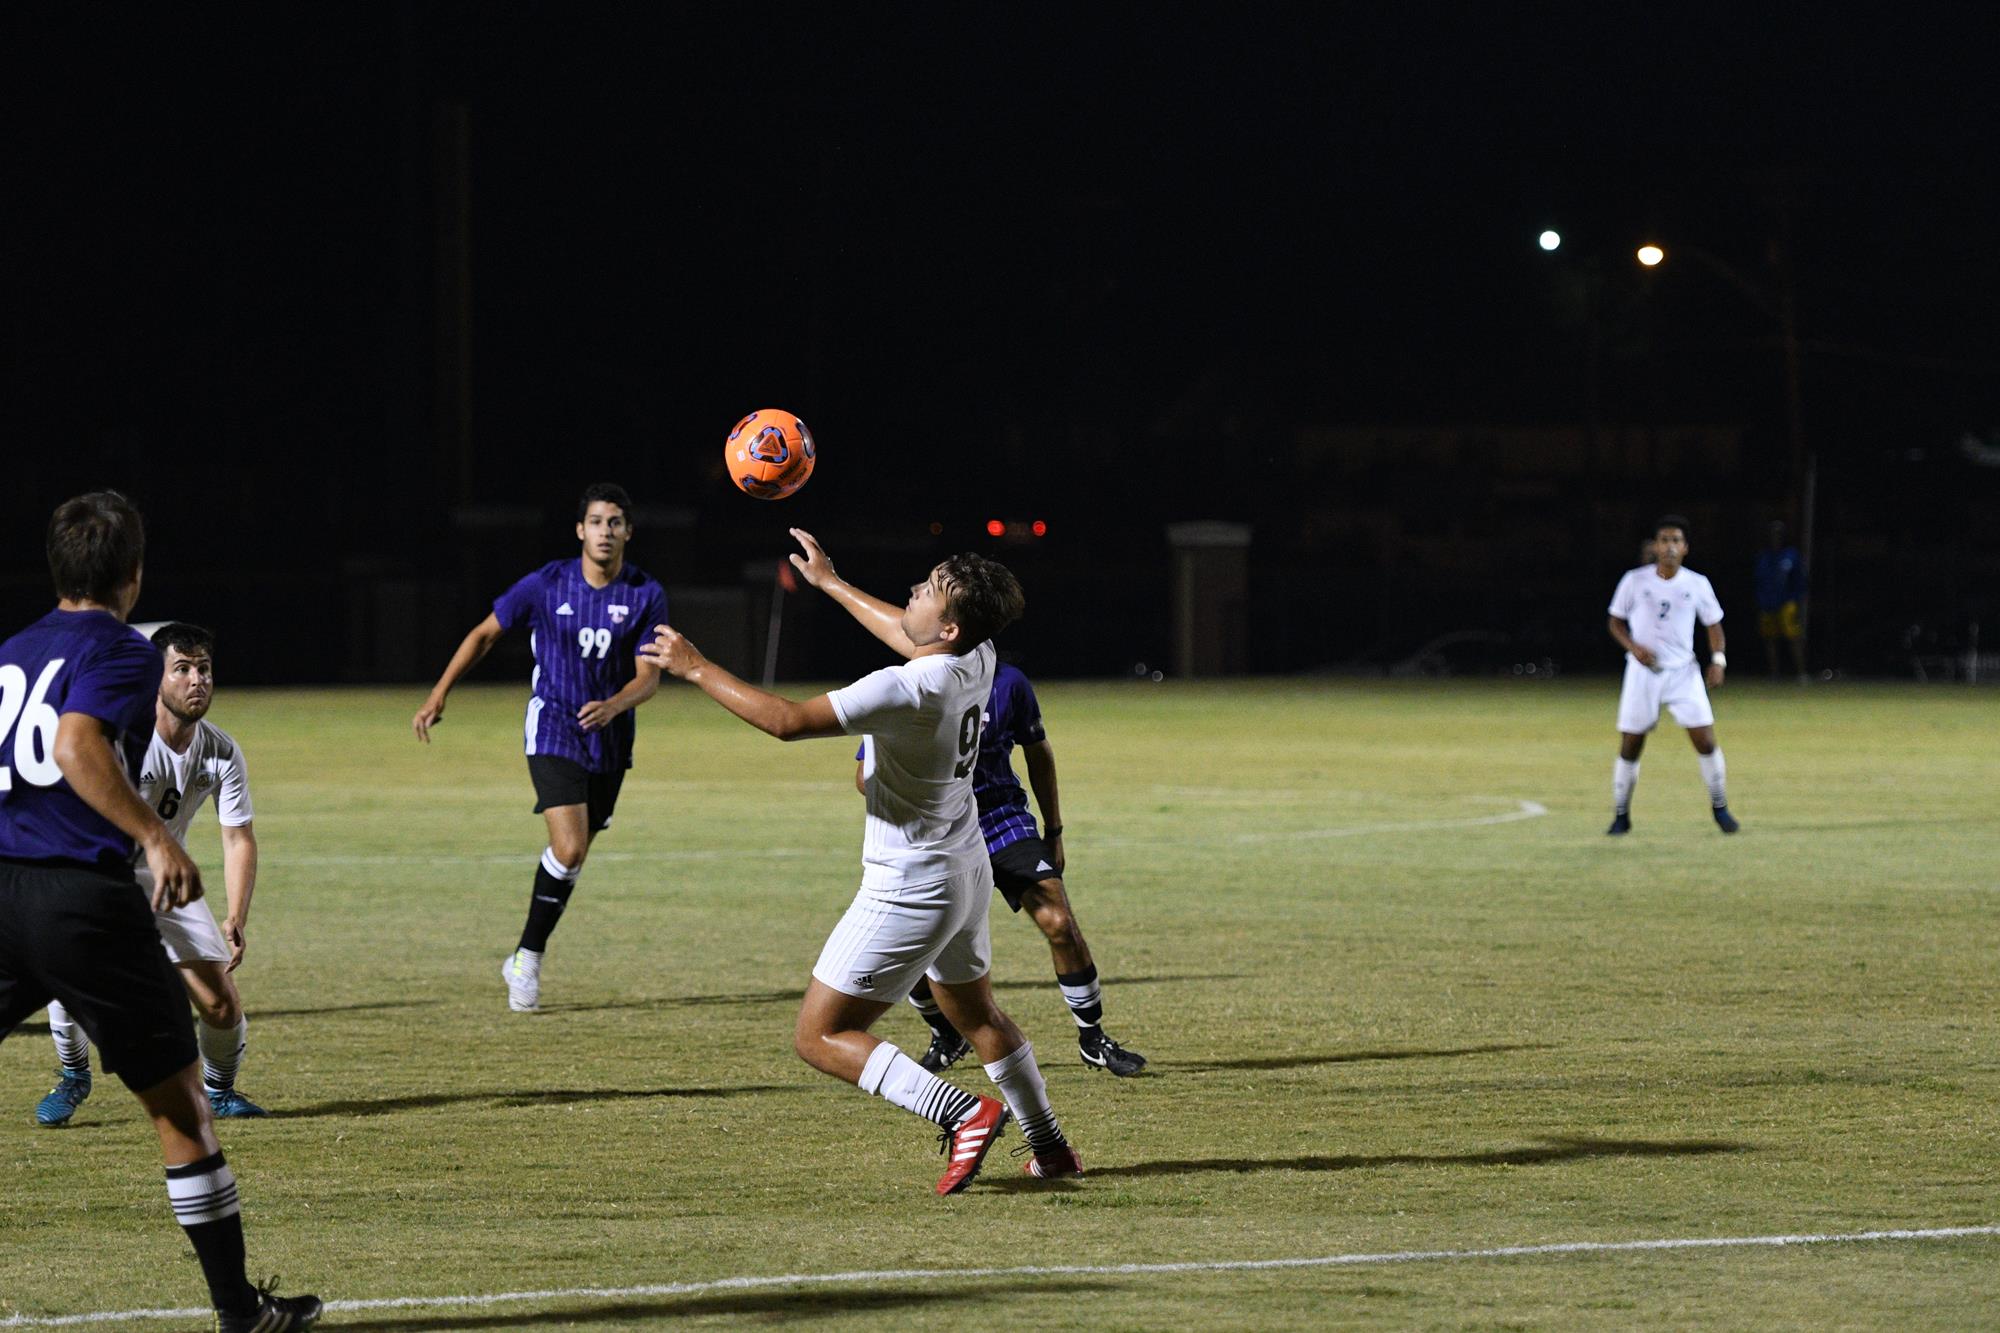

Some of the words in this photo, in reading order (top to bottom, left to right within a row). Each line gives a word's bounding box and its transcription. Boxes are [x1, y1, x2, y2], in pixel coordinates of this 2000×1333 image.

[1658, 600, 1671, 621] 2
[578, 627, 612, 659] 99
[953, 704, 981, 779] 9
[157, 787, 182, 820] 6
